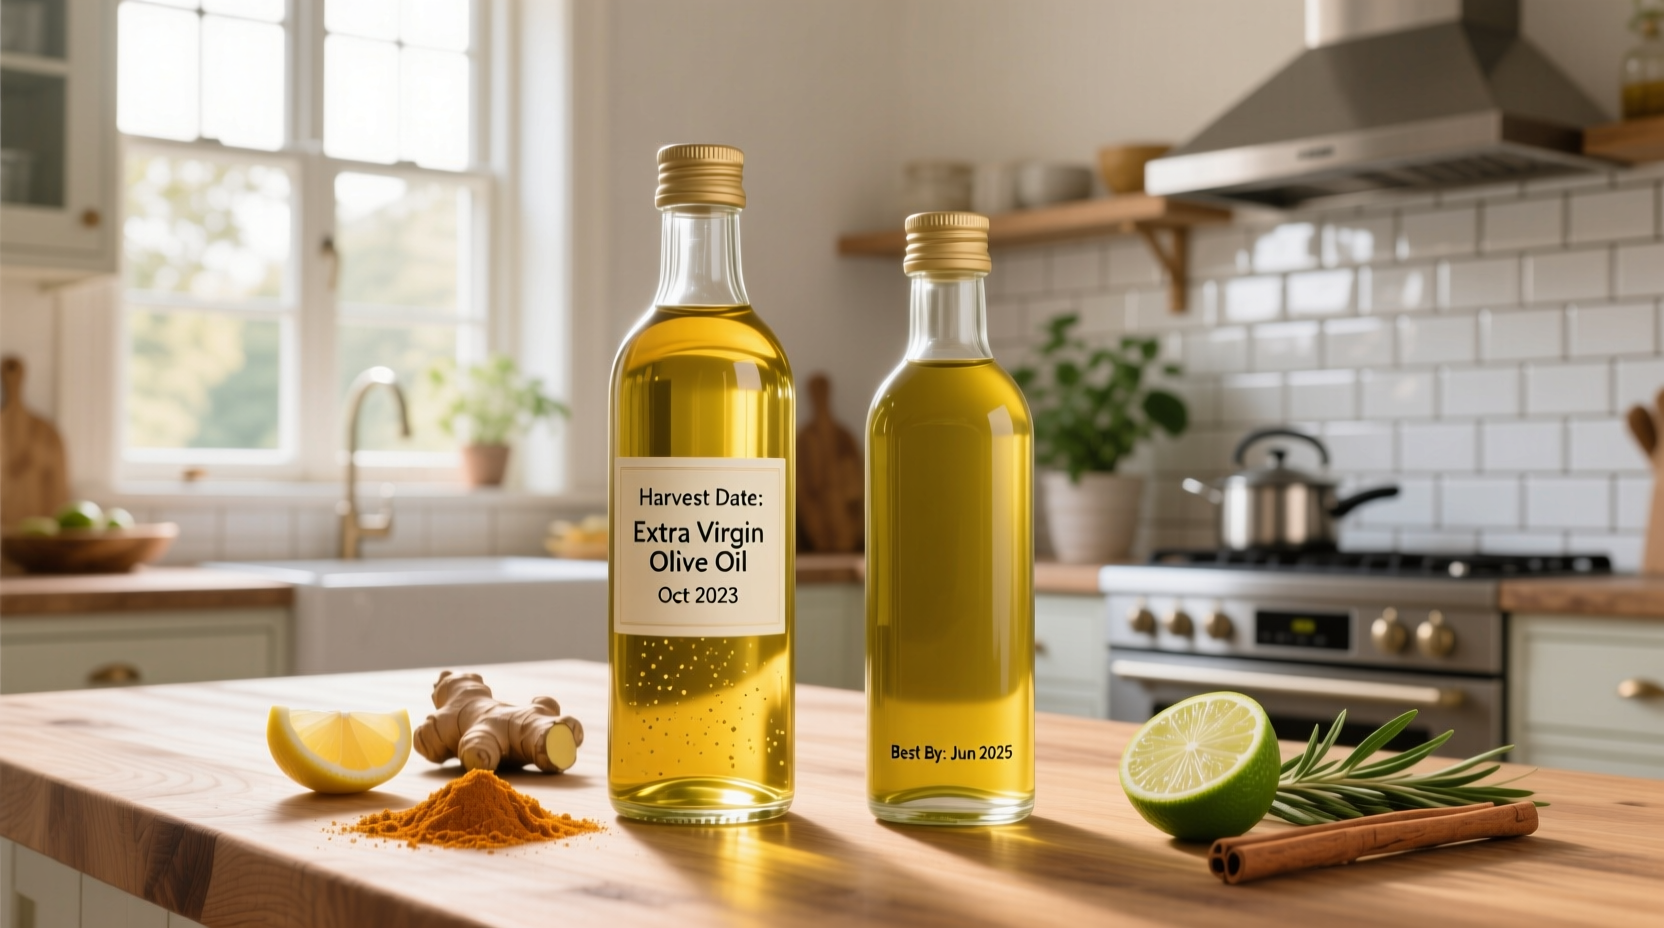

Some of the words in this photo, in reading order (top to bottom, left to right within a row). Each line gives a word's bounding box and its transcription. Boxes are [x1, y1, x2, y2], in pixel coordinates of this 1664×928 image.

[639, 487, 710, 507] Harvest
[715, 488, 763, 507] Date:
[633, 520, 690, 544] Extra
[696, 520, 764, 549] Virgin
[649, 550, 709, 573] Olive
[715, 550, 747, 573] Oil
[658, 586, 691, 604] Oct
[695, 586, 739, 604] 2023
[891, 744, 921, 760] Best
[924, 745, 947, 764] By:
[950, 745, 976, 761] Jun
[979, 744, 1013, 760] 2025
